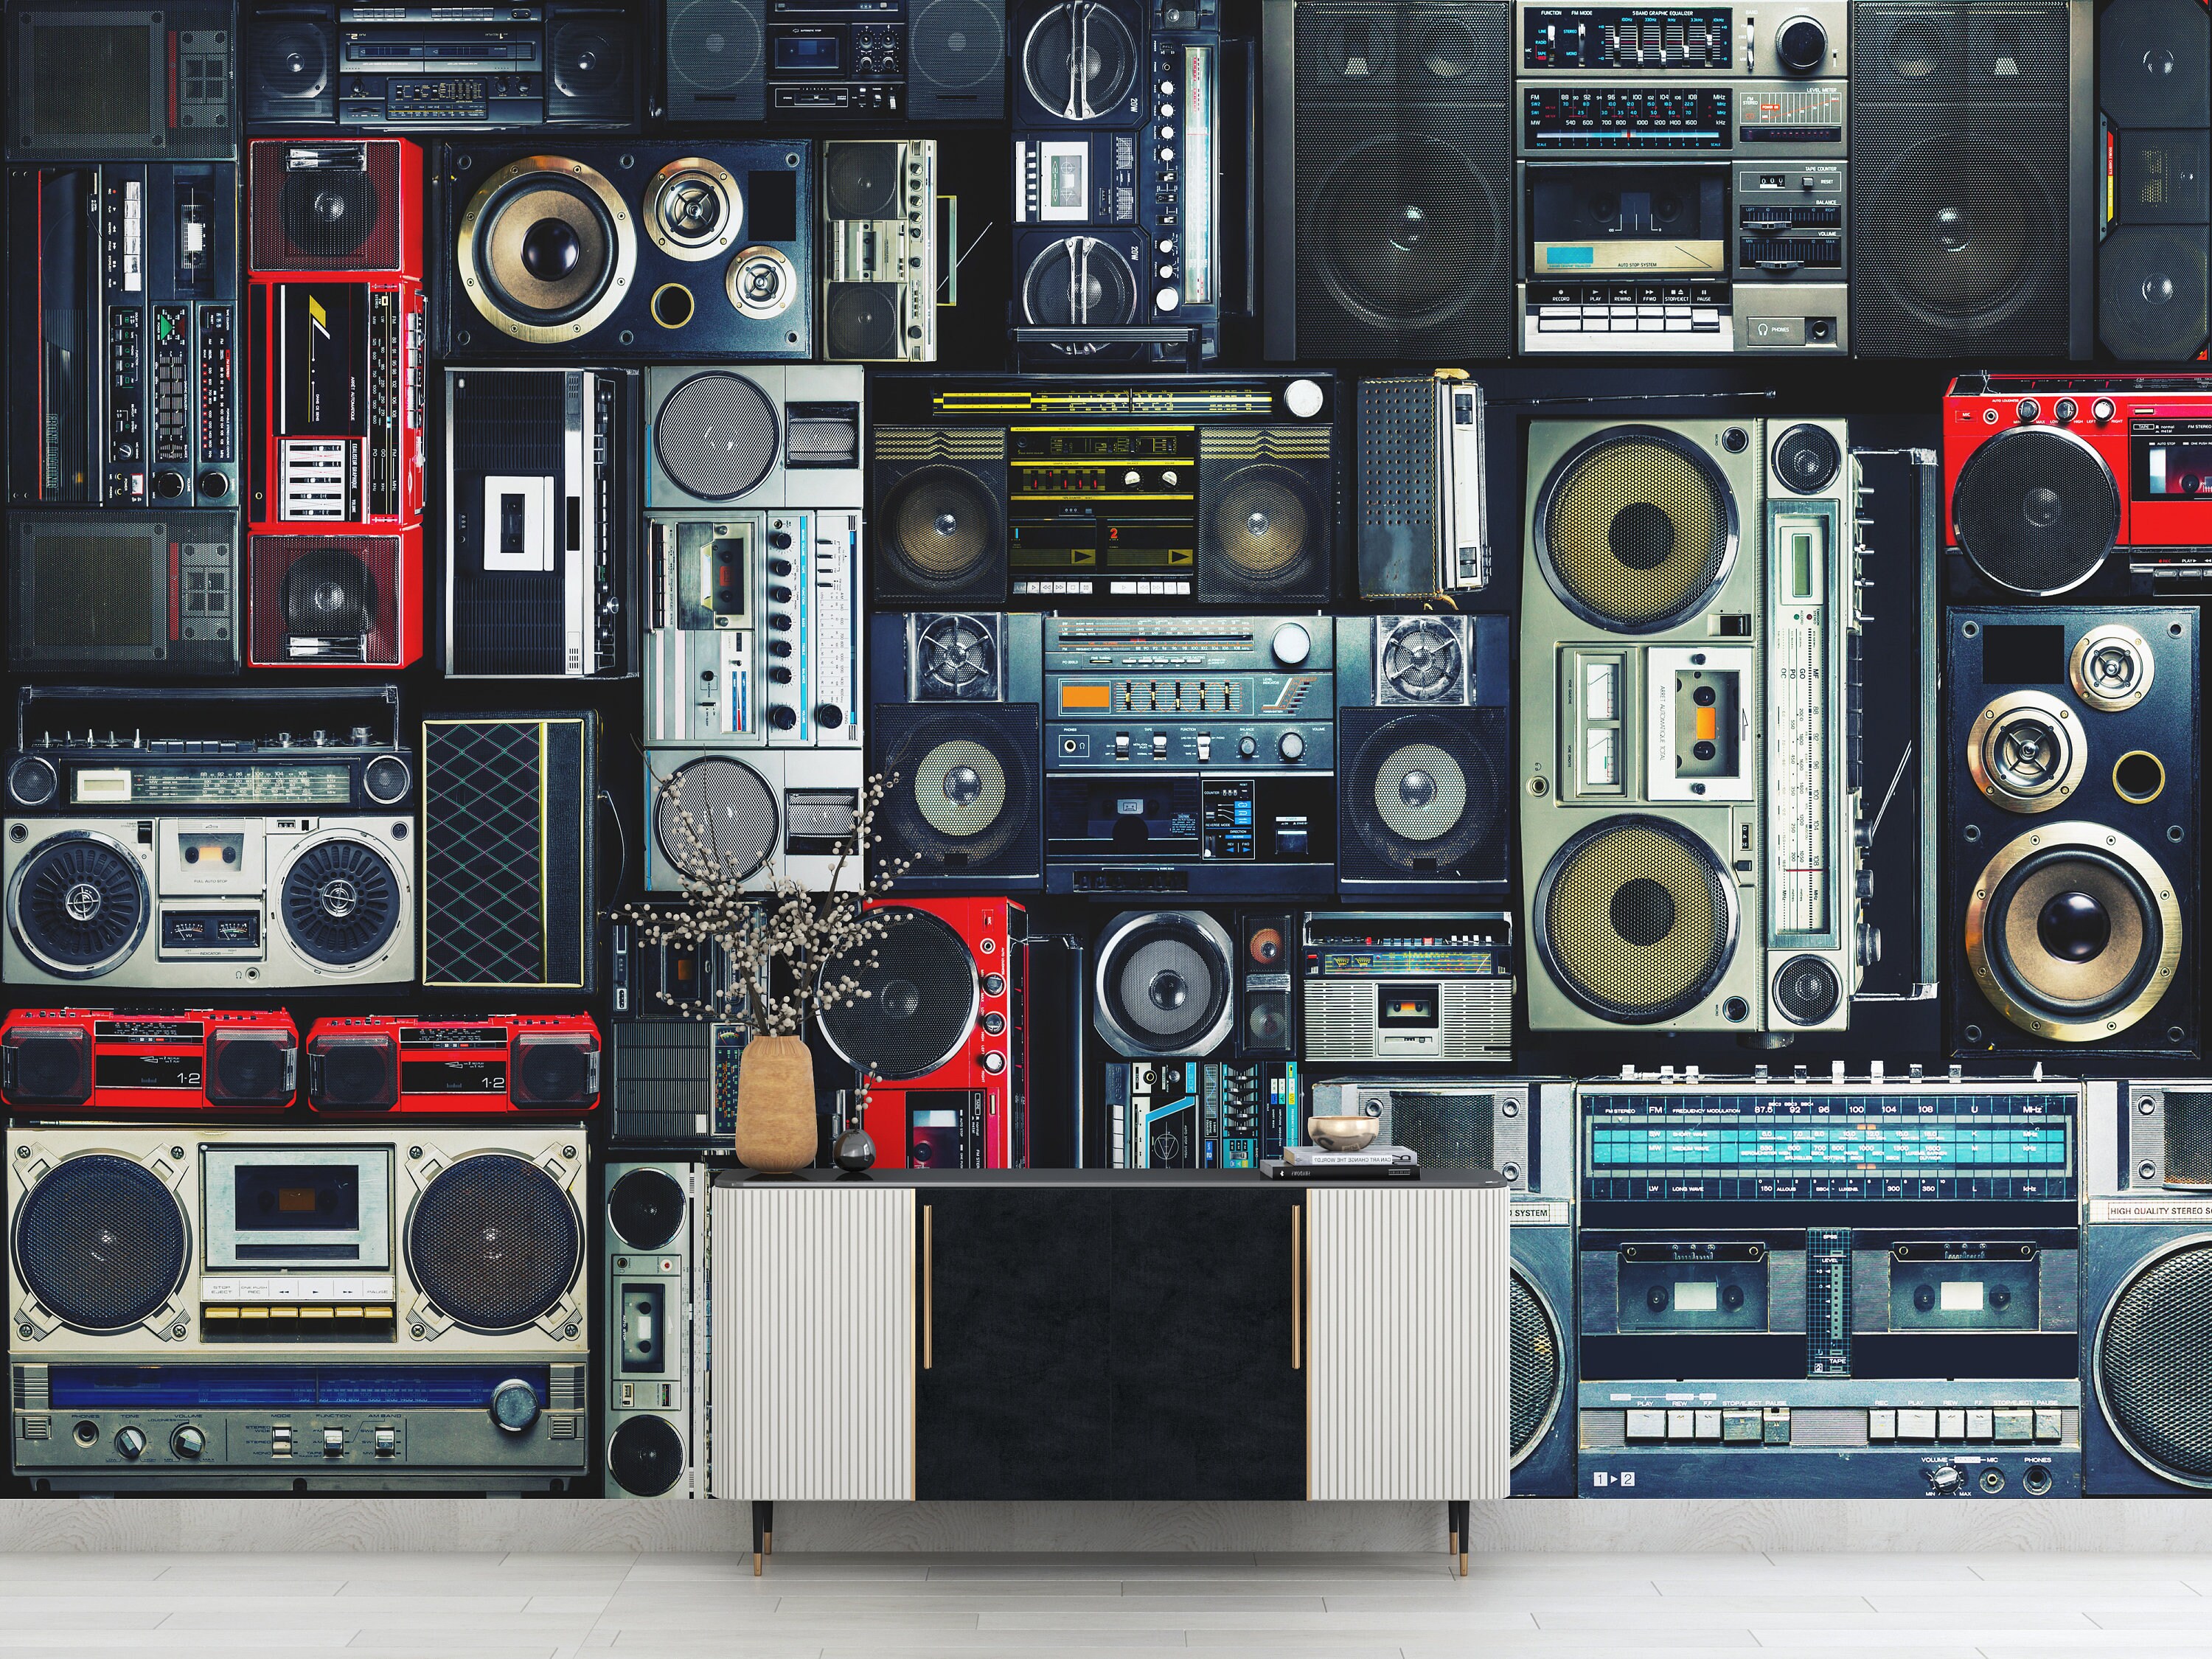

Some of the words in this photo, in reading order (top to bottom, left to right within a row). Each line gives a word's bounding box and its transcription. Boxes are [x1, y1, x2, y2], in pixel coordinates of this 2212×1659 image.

[1130, 97, 1138, 113] 20W
[1130, 246, 1139, 261] 20W
[45, 412, 58, 445] FRONT
[46, 446, 58, 489] LOADING
[1110, 527, 1118, 539] 2
[1781, 667, 1787, 679] OC
[1790, 669, 1796, 680] PO
[1799, 668, 1806, 680] GO
[1812, 668, 1819, 679] MF
[1812, 706, 1820, 715] 88
[1812, 732, 1820, 742] 92
[1813, 760, 1820, 770] 96
[177, 1072, 201, 1084] 1-2
[481, 1077, 505, 1088] 1-2
[1114, 1065, 1122, 1100] STEREO
[1649, 1106, 1663, 1114] FM
[1754, 1105, 1773, 1114] 87.5
[1789, 1105, 1801, 1114] 92
[1818, 1105, 1830, 1113] 96
[1848, 1105, 1865, 1113] 100
[1881, 1105, 1897, 1113] 104
[1918, 1105, 1934, 1113] 108
[1971, 1105, 1978, 1114] U
[2023, 1105, 2043, 1113] MHz
[1624, 1473, 1632, 1485] 2
